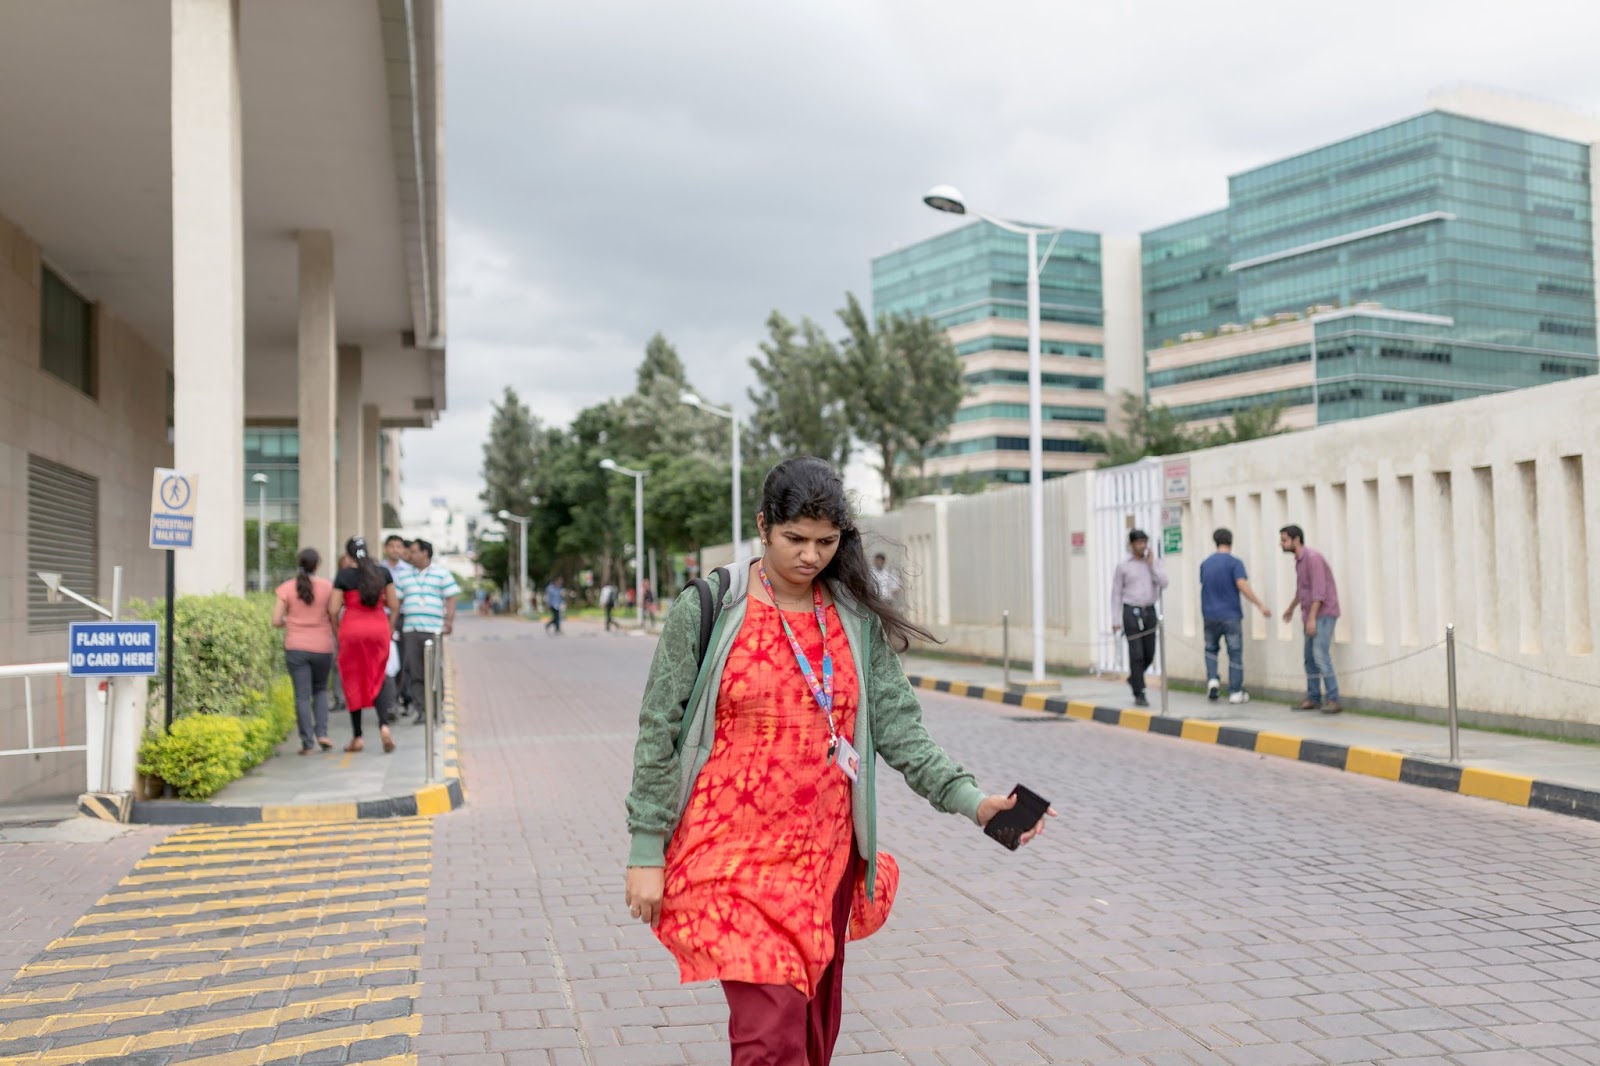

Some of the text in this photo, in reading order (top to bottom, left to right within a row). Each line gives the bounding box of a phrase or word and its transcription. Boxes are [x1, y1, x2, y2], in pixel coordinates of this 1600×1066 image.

[76, 631, 151, 647] FLASH YOUR
[71, 651, 154, 667] ID CARD HERE
